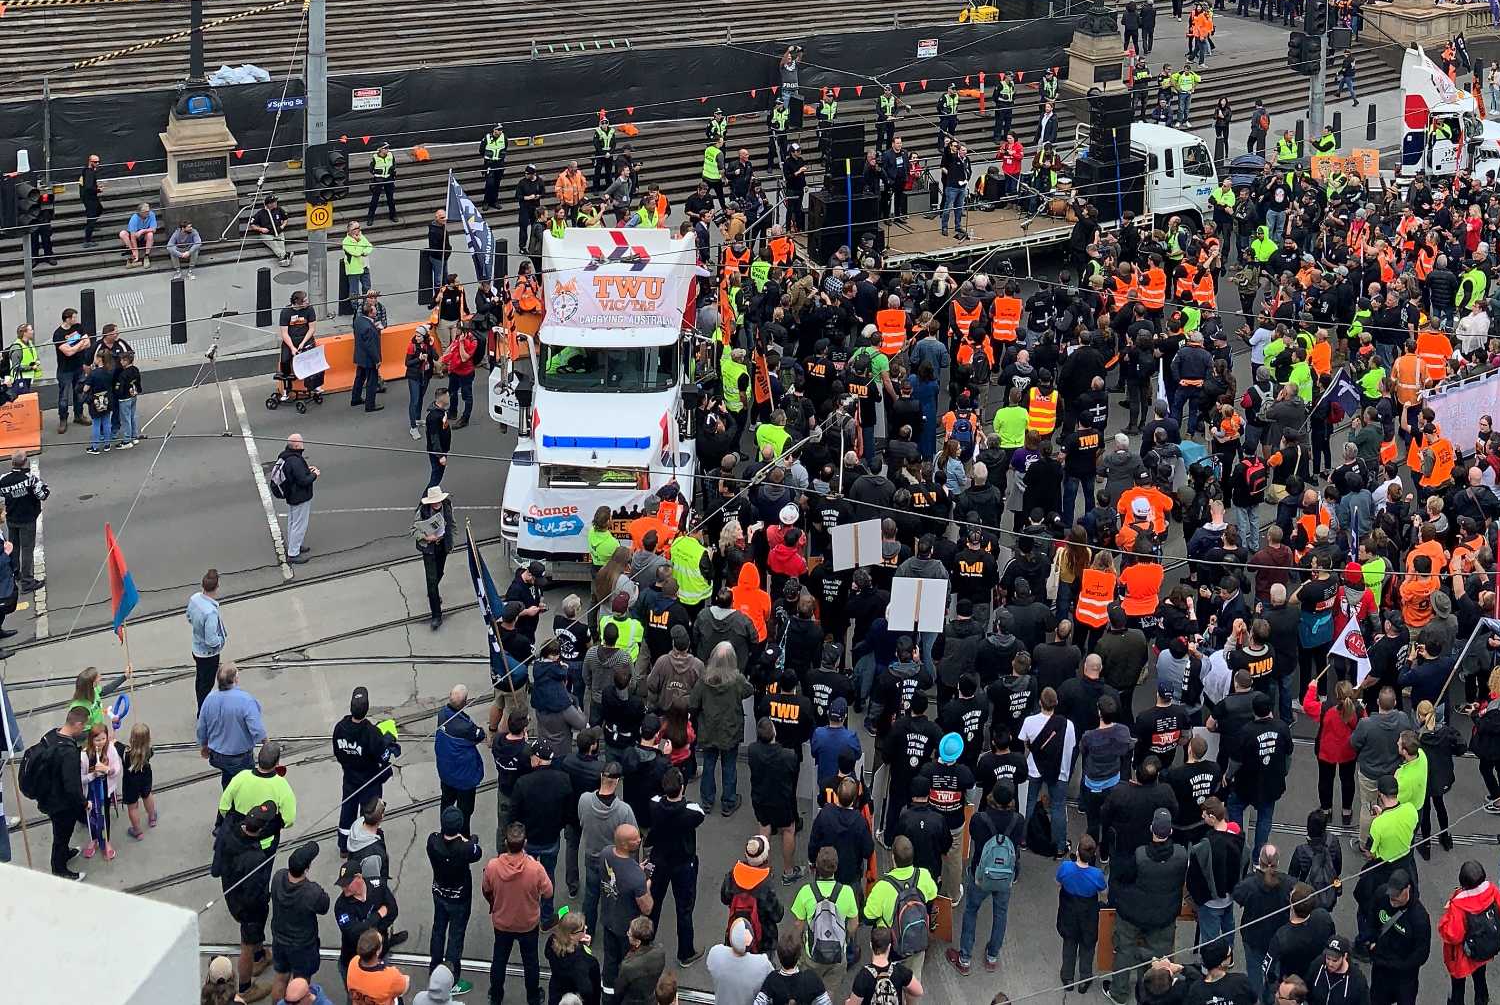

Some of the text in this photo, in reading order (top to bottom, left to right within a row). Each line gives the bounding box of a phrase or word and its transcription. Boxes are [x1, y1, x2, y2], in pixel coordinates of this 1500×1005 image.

[272, 98, 304, 109] Spring St
[315, 211, 325, 221] 10
[592, 275, 665, 300] TWU
[578, 313, 624, 325] CARRYING
[1079, 434, 1099, 447] TWU
[528, 504, 578, 517] Change
[534, 520, 577, 532] RULES
[959, 561, 984, 574] TWU
[1248, 657, 1273, 675] TWU
[770, 701, 800, 720] TWU
[994, 764, 1017, 776] FIGHTING
[1190, 773, 1214, 784] FIGHTING
[1193, 788, 1210, 798] FUTURE
